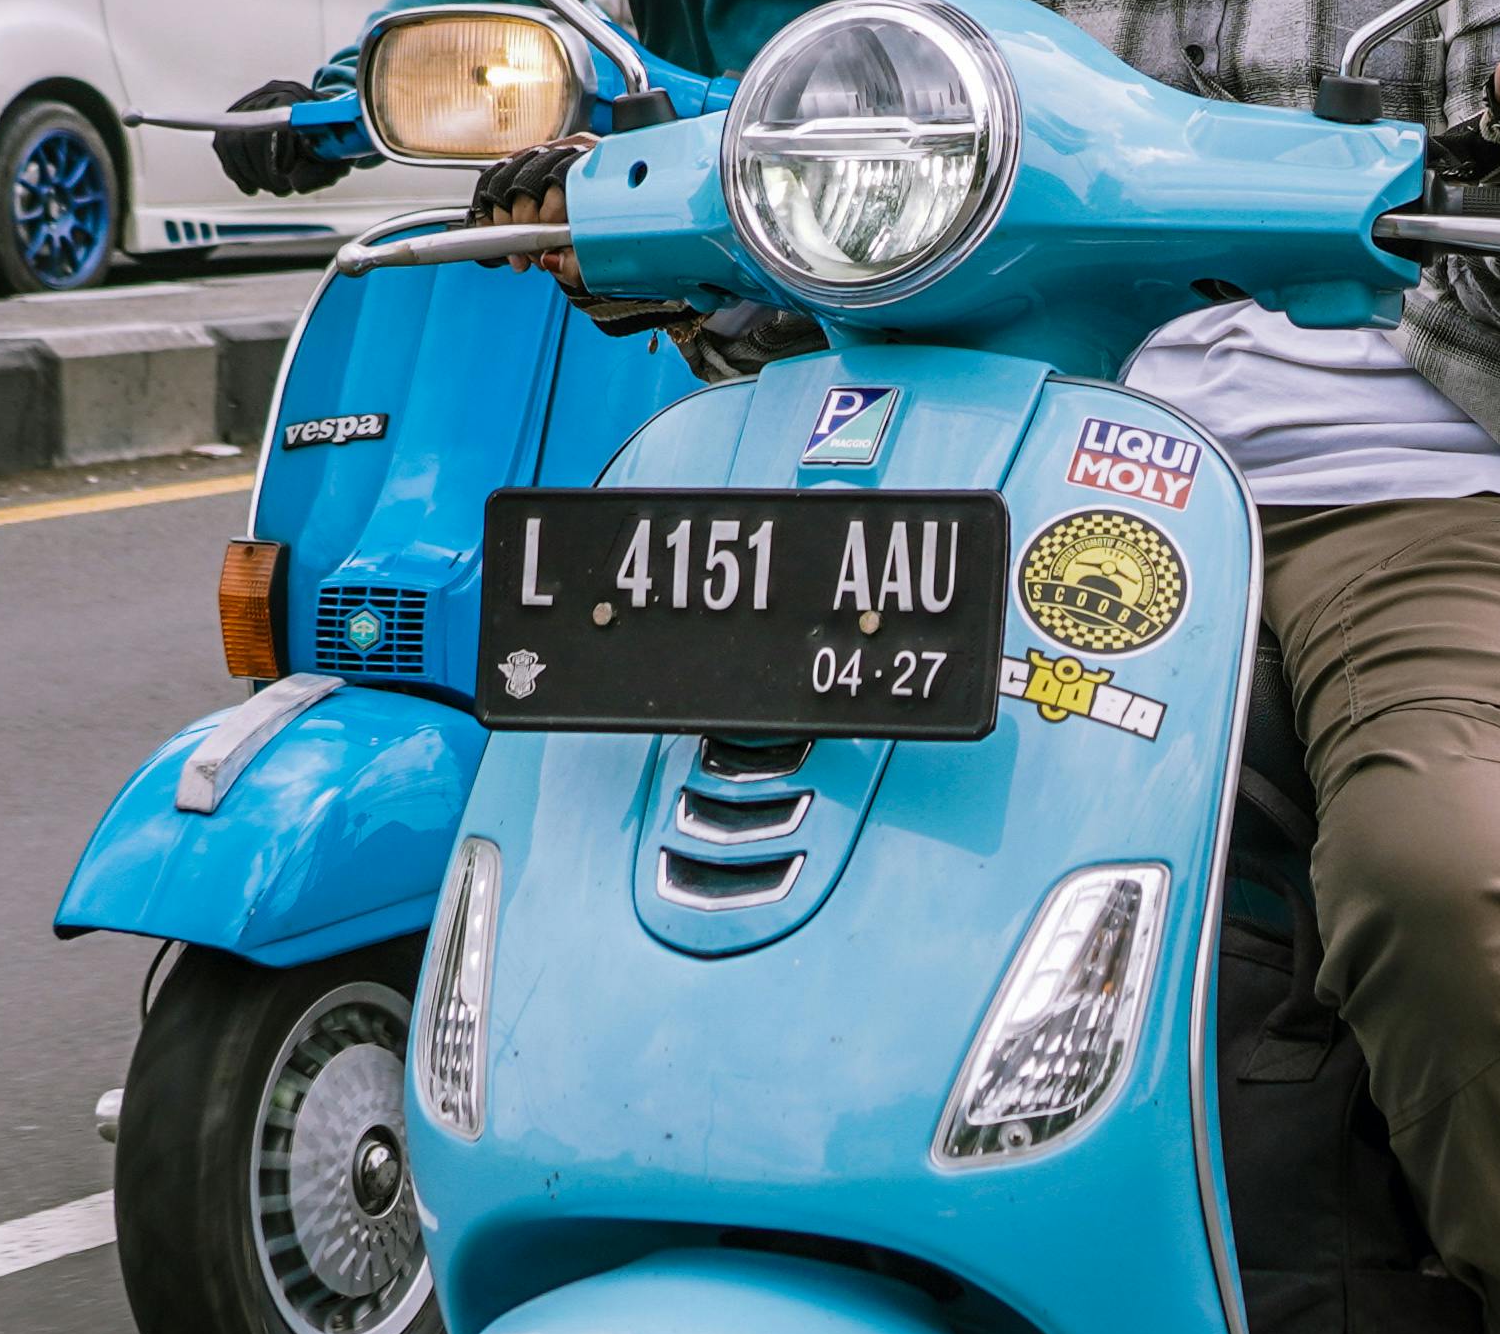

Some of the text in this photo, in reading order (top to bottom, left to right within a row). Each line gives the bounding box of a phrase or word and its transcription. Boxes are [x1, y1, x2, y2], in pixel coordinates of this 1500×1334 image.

[285, 414, 383, 444] vespa
[815, 390, 864, 435] P
[1082, 421, 1198, 475] LIQUI
[1073, 453, 1191, 505] MOLY
[521, 518, 959, 614] L 4151 AAU
[1032, 583, 1150, 637] SCOOBA
[999, 656, 1164, 741] COOBA
